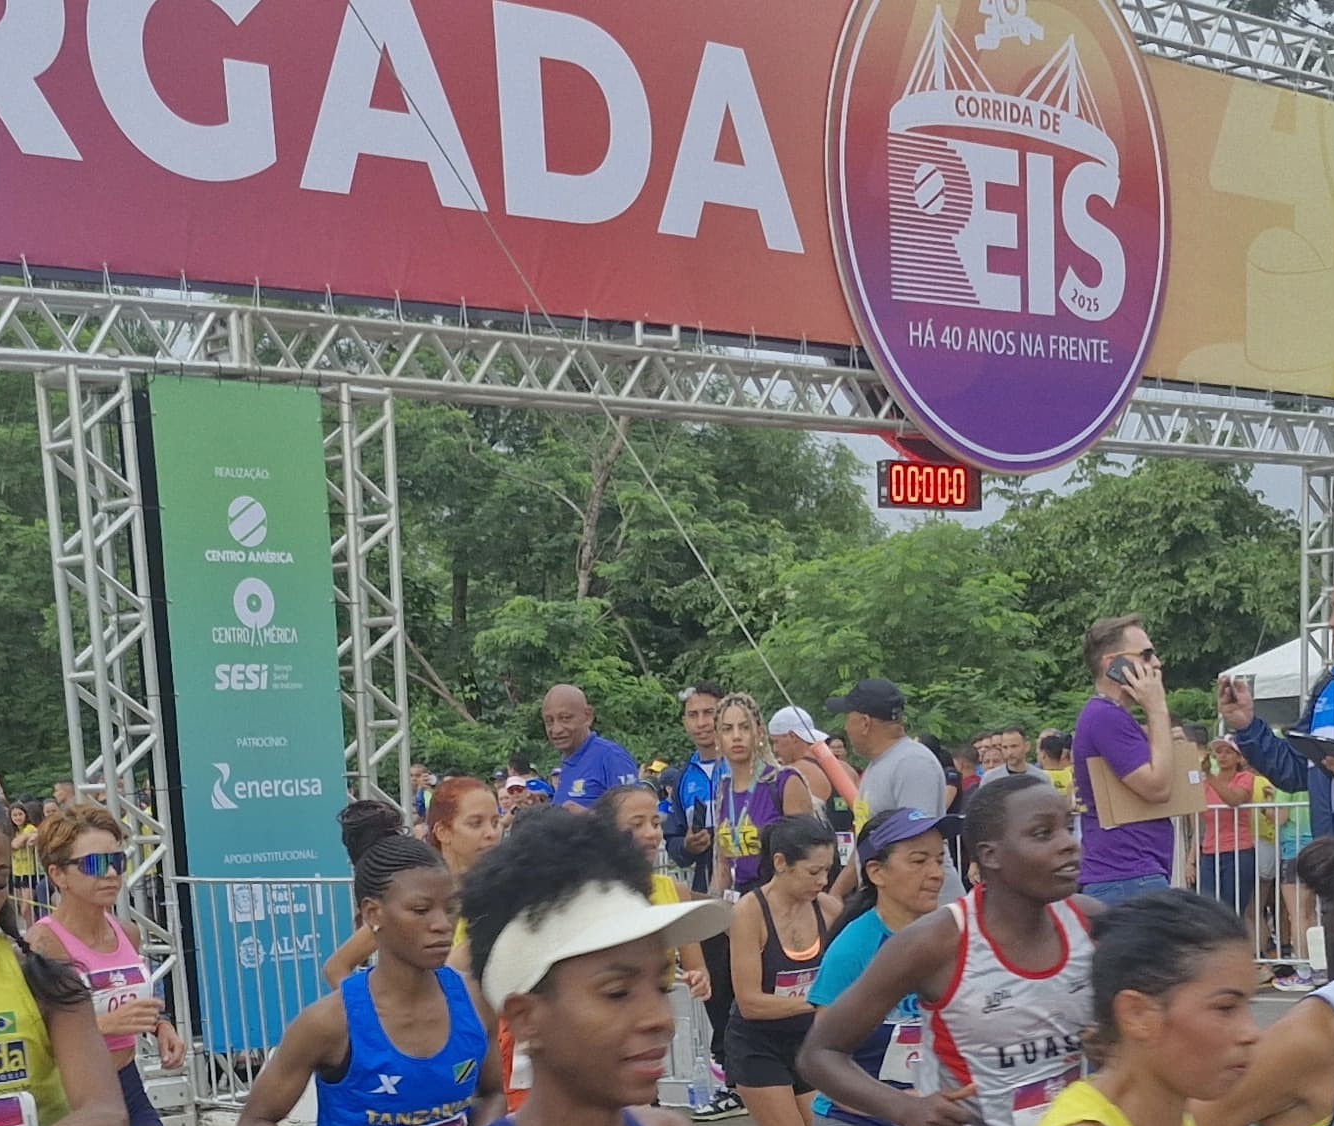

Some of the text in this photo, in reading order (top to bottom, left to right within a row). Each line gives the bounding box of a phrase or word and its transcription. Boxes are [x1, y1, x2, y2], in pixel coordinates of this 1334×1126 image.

[955, 95, 1061, 133] CORRIDA DE
[887, 128, 1126, 322] REIS
[1070, 287, 1100, 313] 2025
[908, 318, 1114, 364] HÁ 40 ANOS NA FRENTE.
[205, 549, 294, 565] CENTRO AMÉRICA
[224, 852, 251, 865] APOIO
